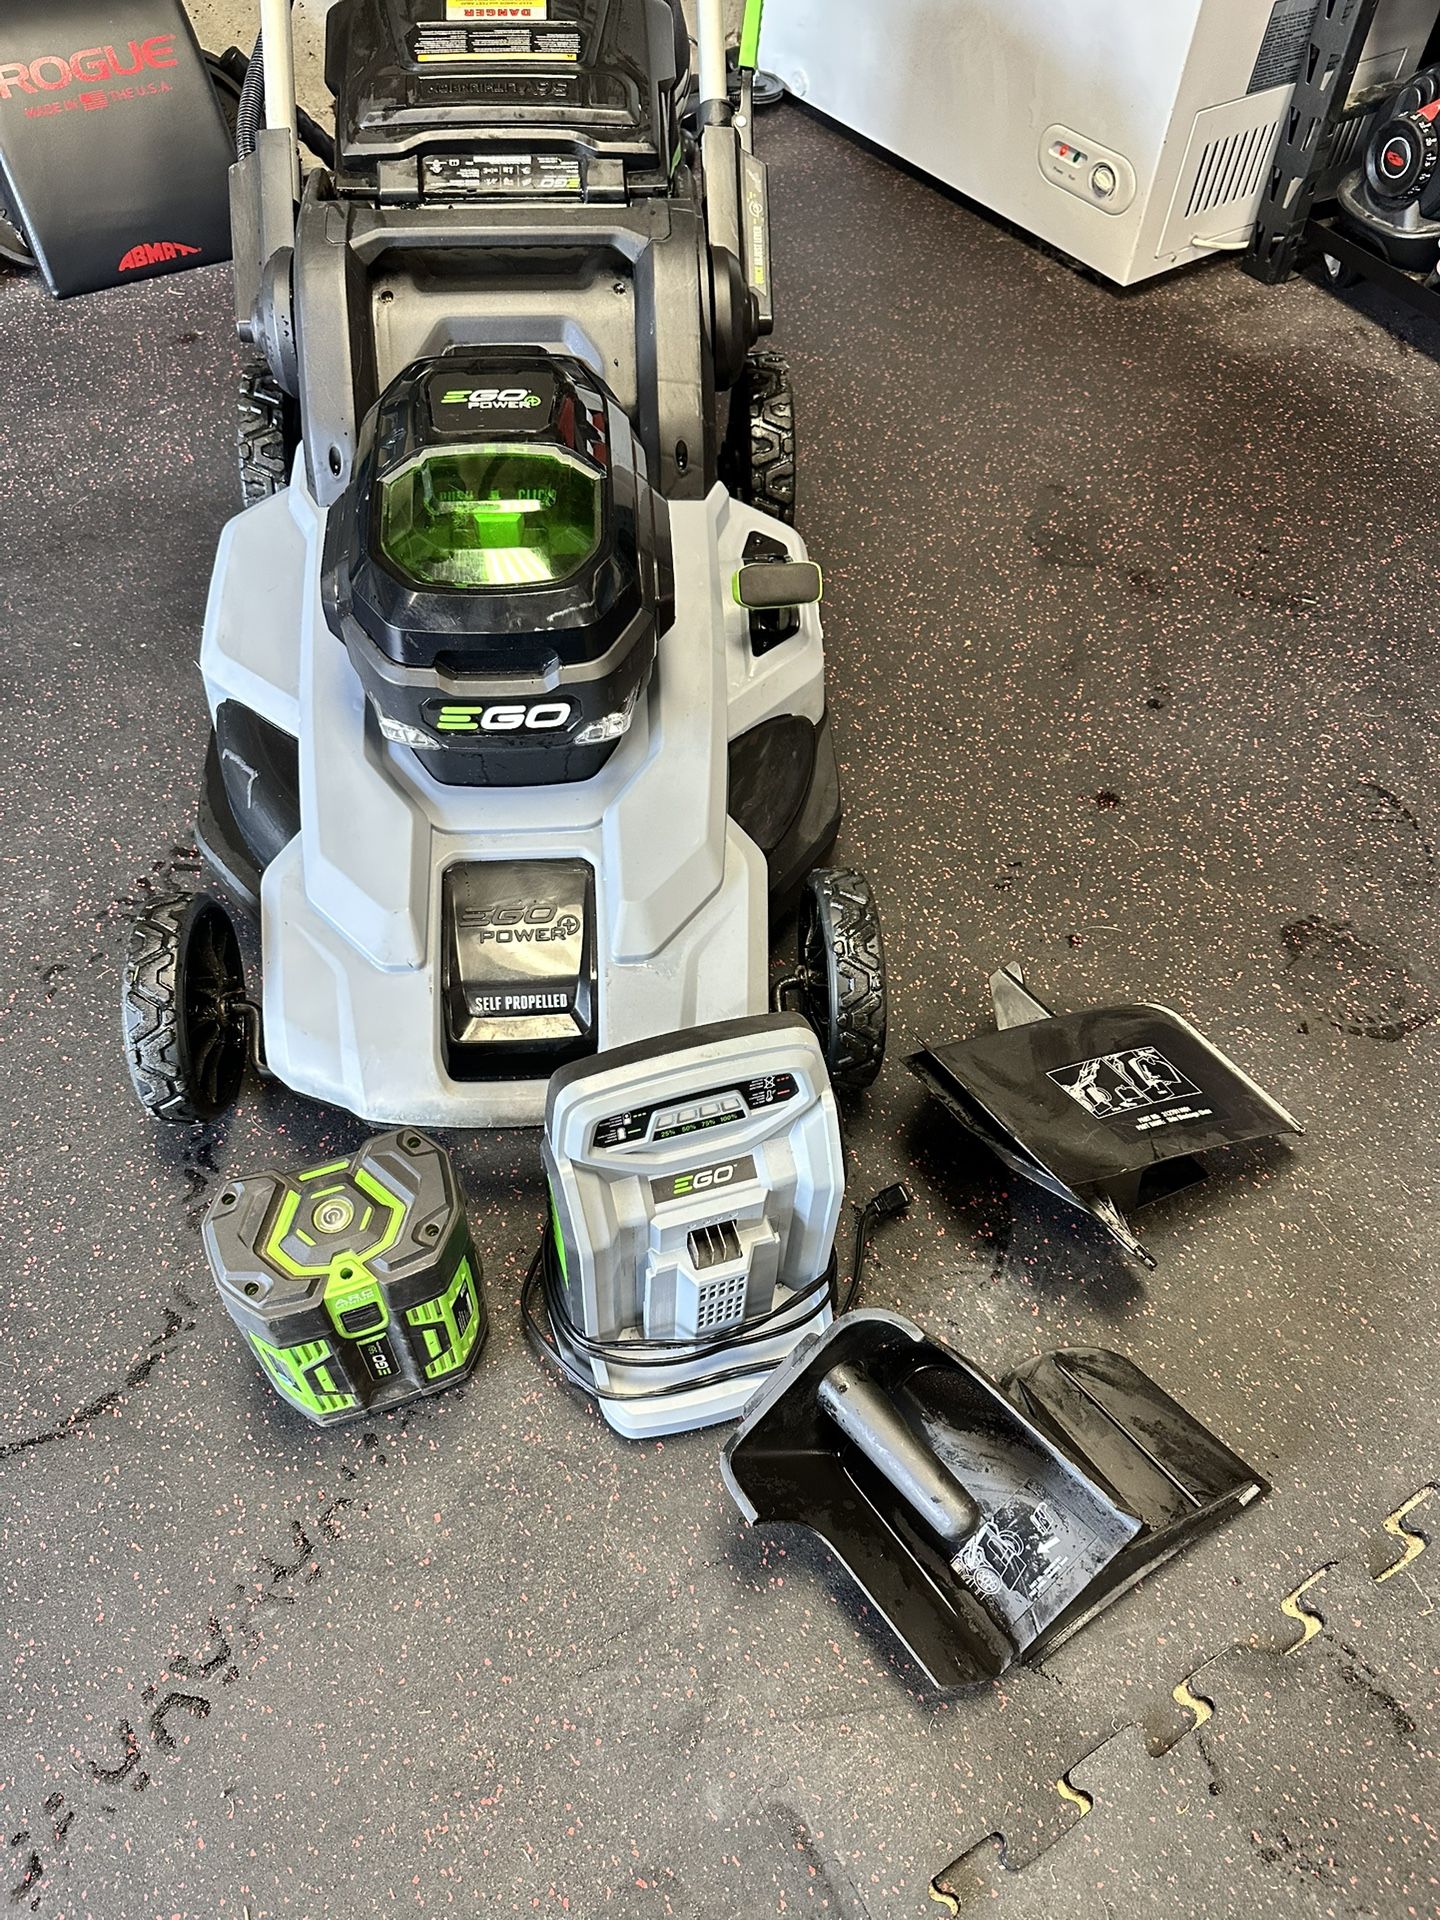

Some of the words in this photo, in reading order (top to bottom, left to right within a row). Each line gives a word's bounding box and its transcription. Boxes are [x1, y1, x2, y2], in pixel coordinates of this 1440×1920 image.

[463, 8, 532, 17] DANGER
[0, 33, 177, 99] ROGUE
[441, 389, 528, 404] EGO
[436, 702, 571, 731] EGO
[460, 903, 557, 928] EGO
[480, 928, 566, 944] POWER
[475, 997, 502, 1011] SELF
[505, 994, 568, 1010] PROPELLED
[661, 1129, 675, 1138] 25%
[674, 1164, 734, 1194] EGO
[372, 1354, 392, 1376] EGO
